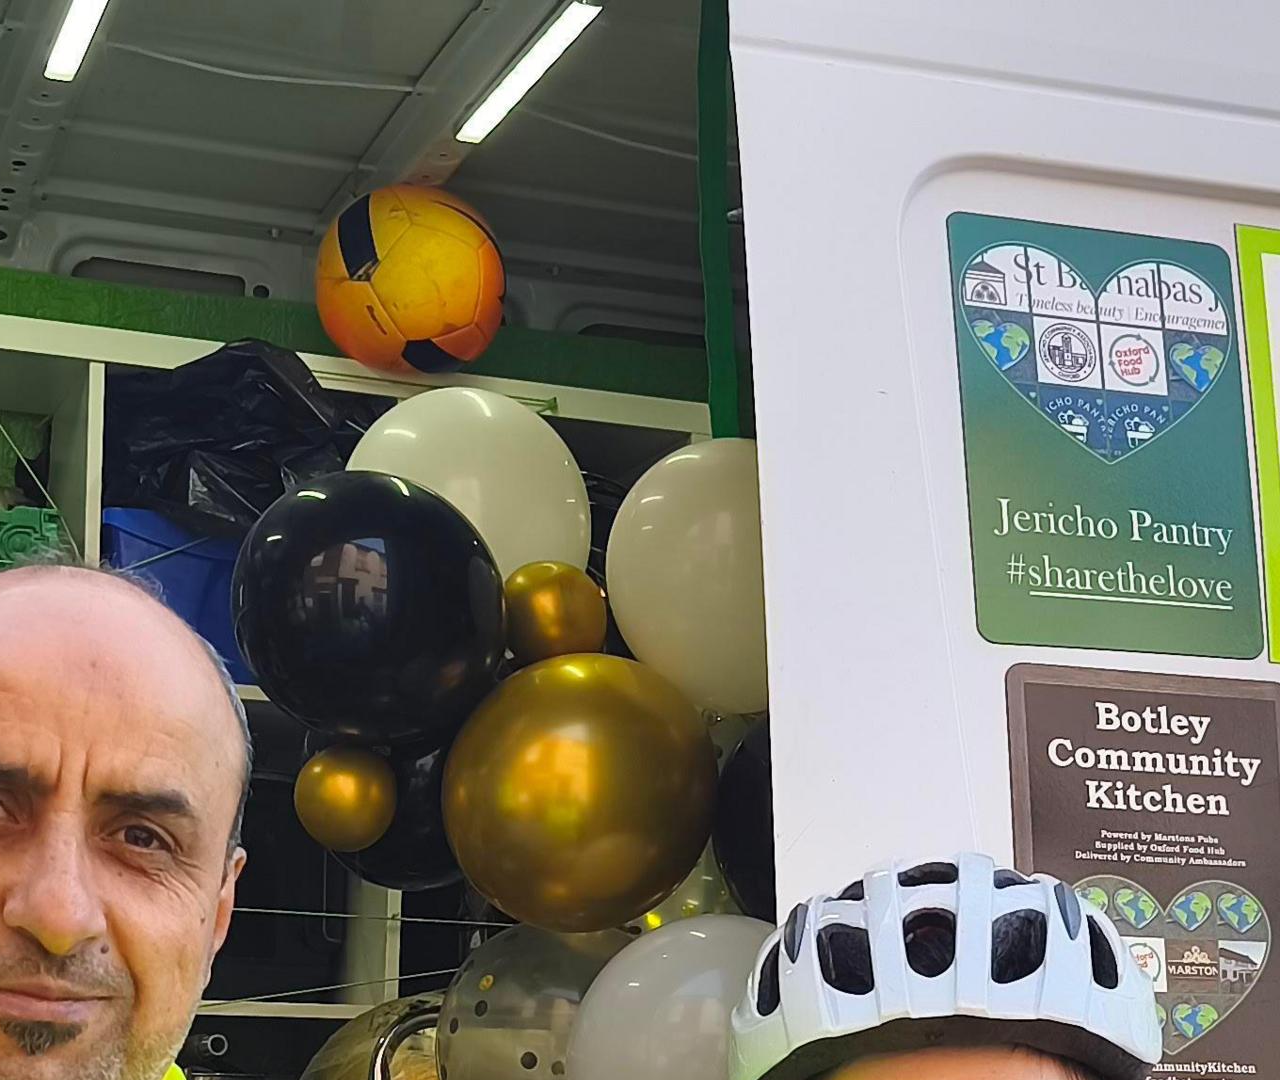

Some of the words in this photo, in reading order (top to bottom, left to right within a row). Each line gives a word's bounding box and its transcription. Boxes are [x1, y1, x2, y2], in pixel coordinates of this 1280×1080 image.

[1013, 253, 1045, 286] St
[994, 498, 1118, 539] Jericho
[1129, 510, 1233, 555] Pantry
[1007, 553, 1233, 601] #sharethelove
[1095, 701, 1210, 744] Botley
[1047, 738, 1261, 786] Community
[1085, 780, 1230, 816] Kitchen
[1095, 841, 1134, 852] Supplied
[1137, 843, 1148, 854] by
[1150, 844, 1180, 853] Oxford
[1100, 830, 1138, 841] Powered
[1141, 831, 1152, 842] by
[1154, 833, 1195, 843] Marstons
[1198, 835, 1219, 844] Pubs
[1075, 850, 1117, 861] Delivered
[1120, 852, 1131, 863] by
[1134, 854, 1186, 866] Community
